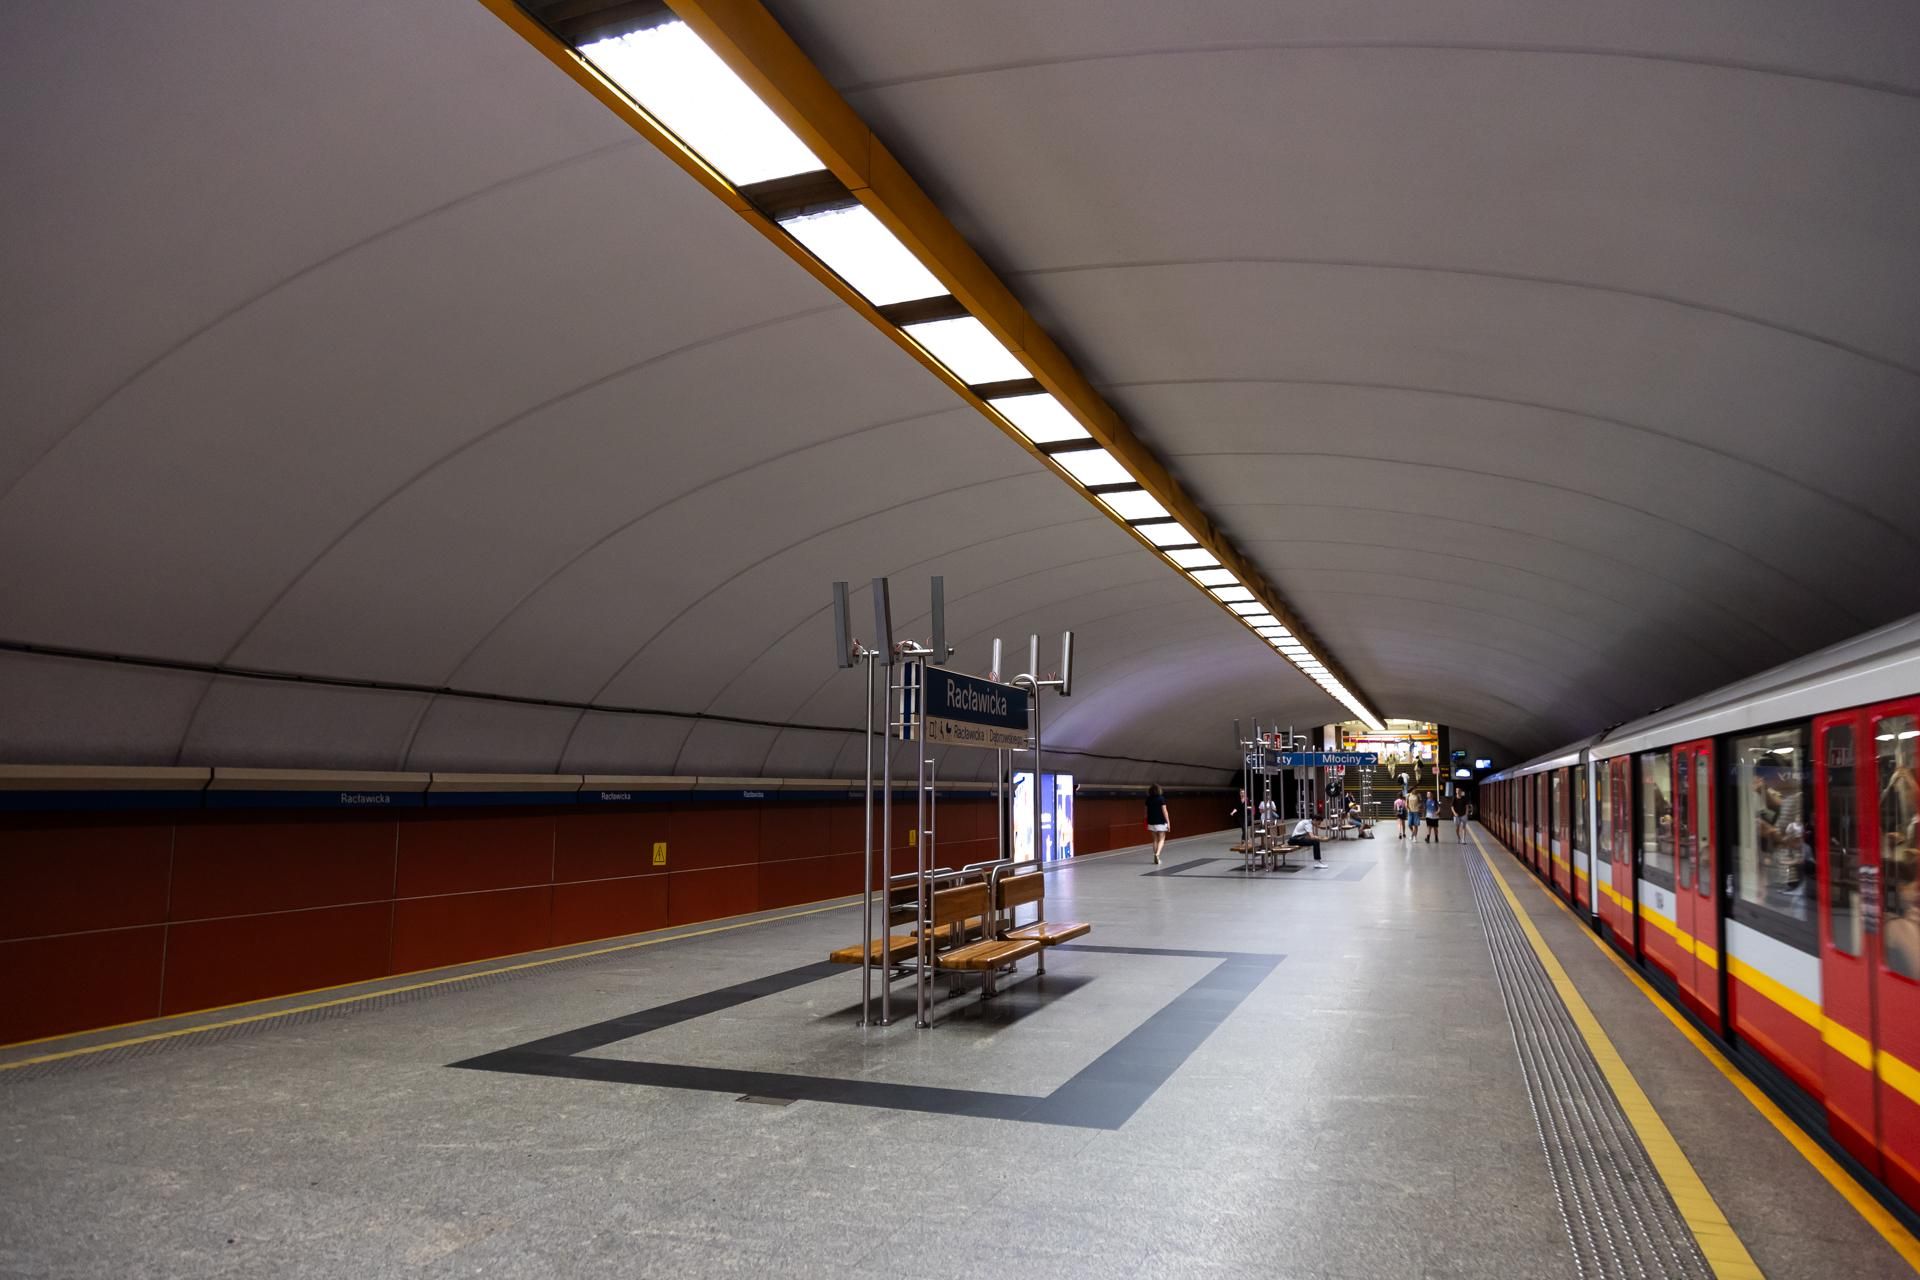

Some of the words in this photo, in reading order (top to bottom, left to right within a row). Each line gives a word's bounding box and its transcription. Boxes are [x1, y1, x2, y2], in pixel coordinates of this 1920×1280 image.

[946, 678, 1007, 716] Racławicka
[1322, 754, 1362, 765] Młociny
[340, 793, 391, 804] Racławicka
